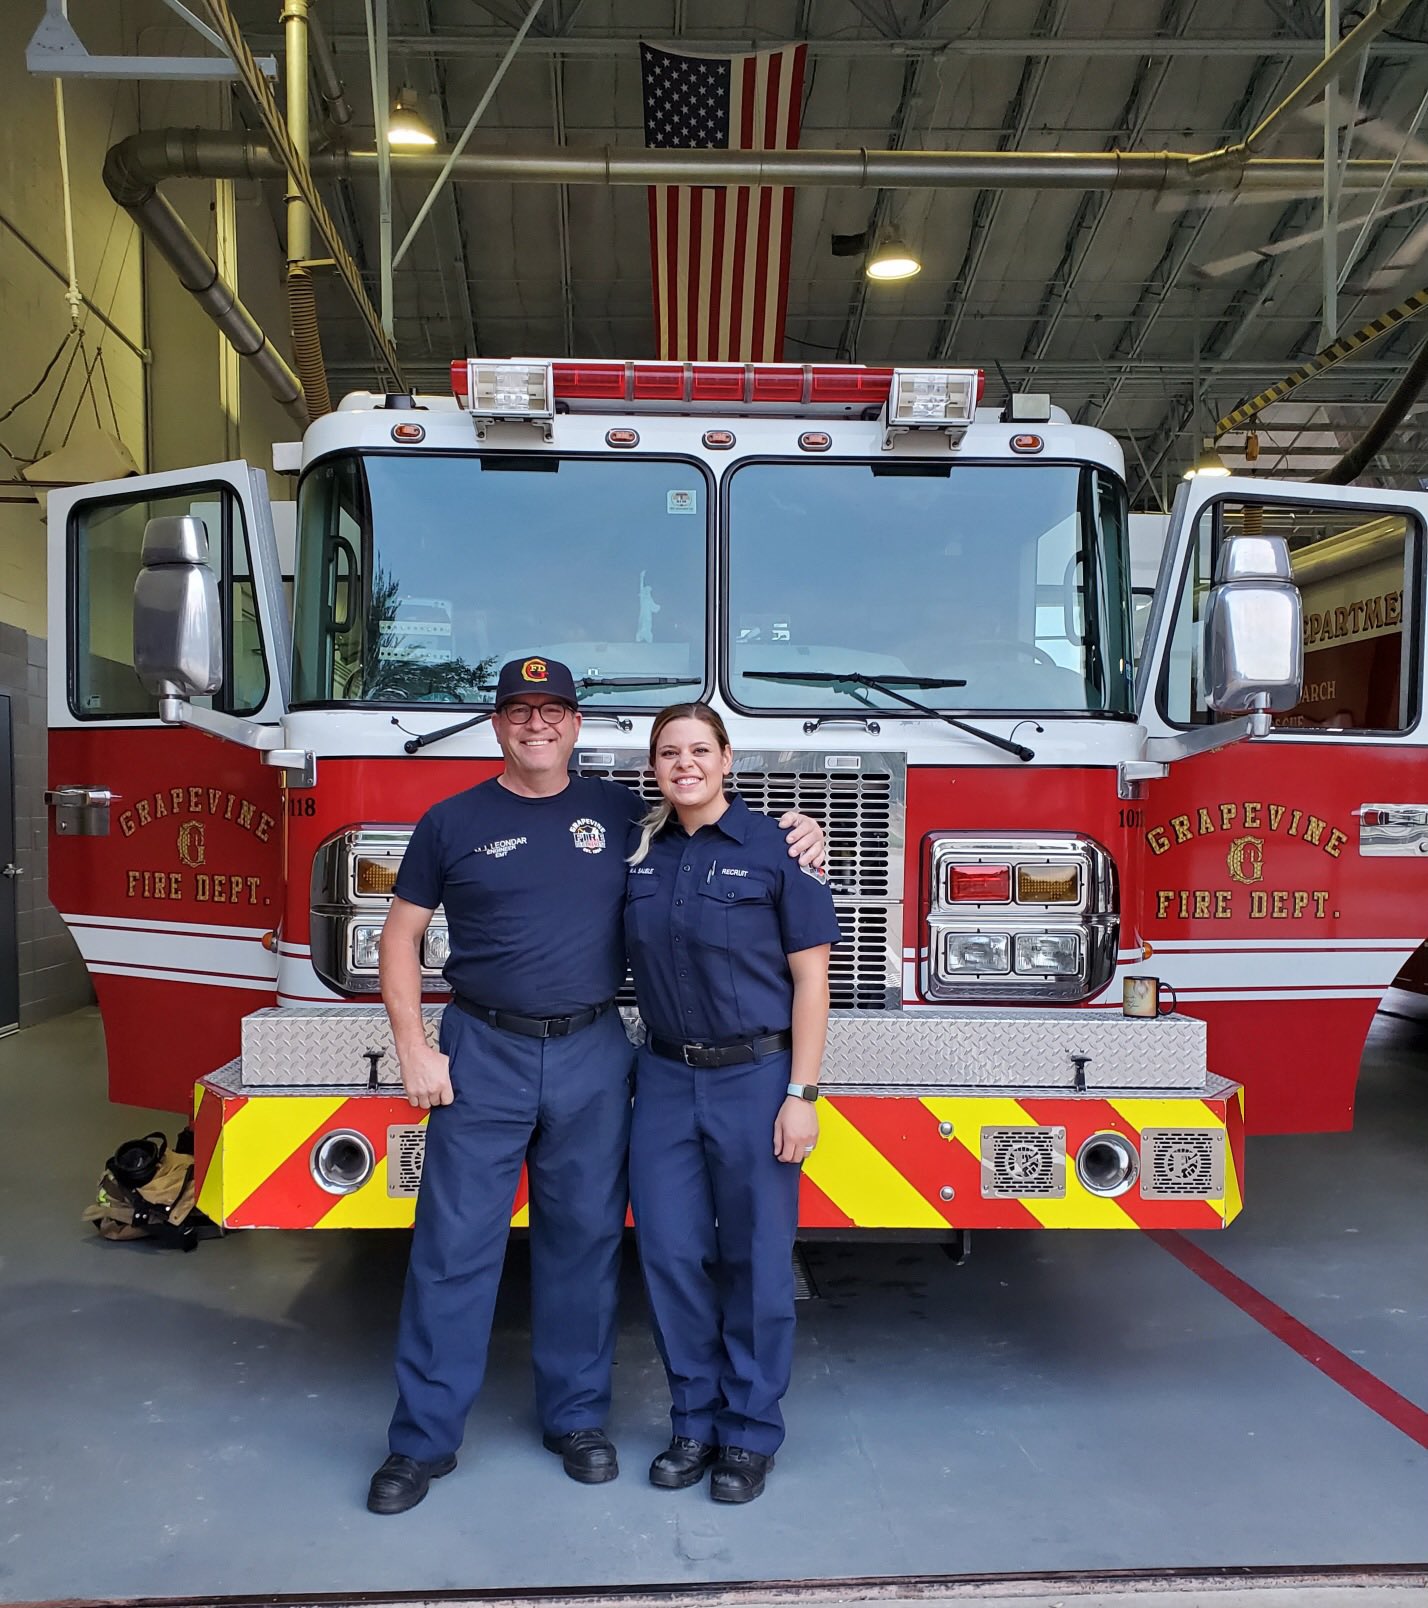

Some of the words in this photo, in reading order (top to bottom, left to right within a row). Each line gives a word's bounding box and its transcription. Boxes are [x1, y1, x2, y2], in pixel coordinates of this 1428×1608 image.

[118, 787, 275, 843] GRAPEVINE
[569, 818, 606, 833] GRAPEVINE
[1146, 802, 1349, 858] GRAPEVINE
[127, 870, 183, 900] FIRE
[196, 874, 271, 905] DEPT.
[721, 868, 749, 877] RECRUIT
[1156, 890, 1232, 919] FIRE
[1249, 890, 1341, 919] DEPT.
